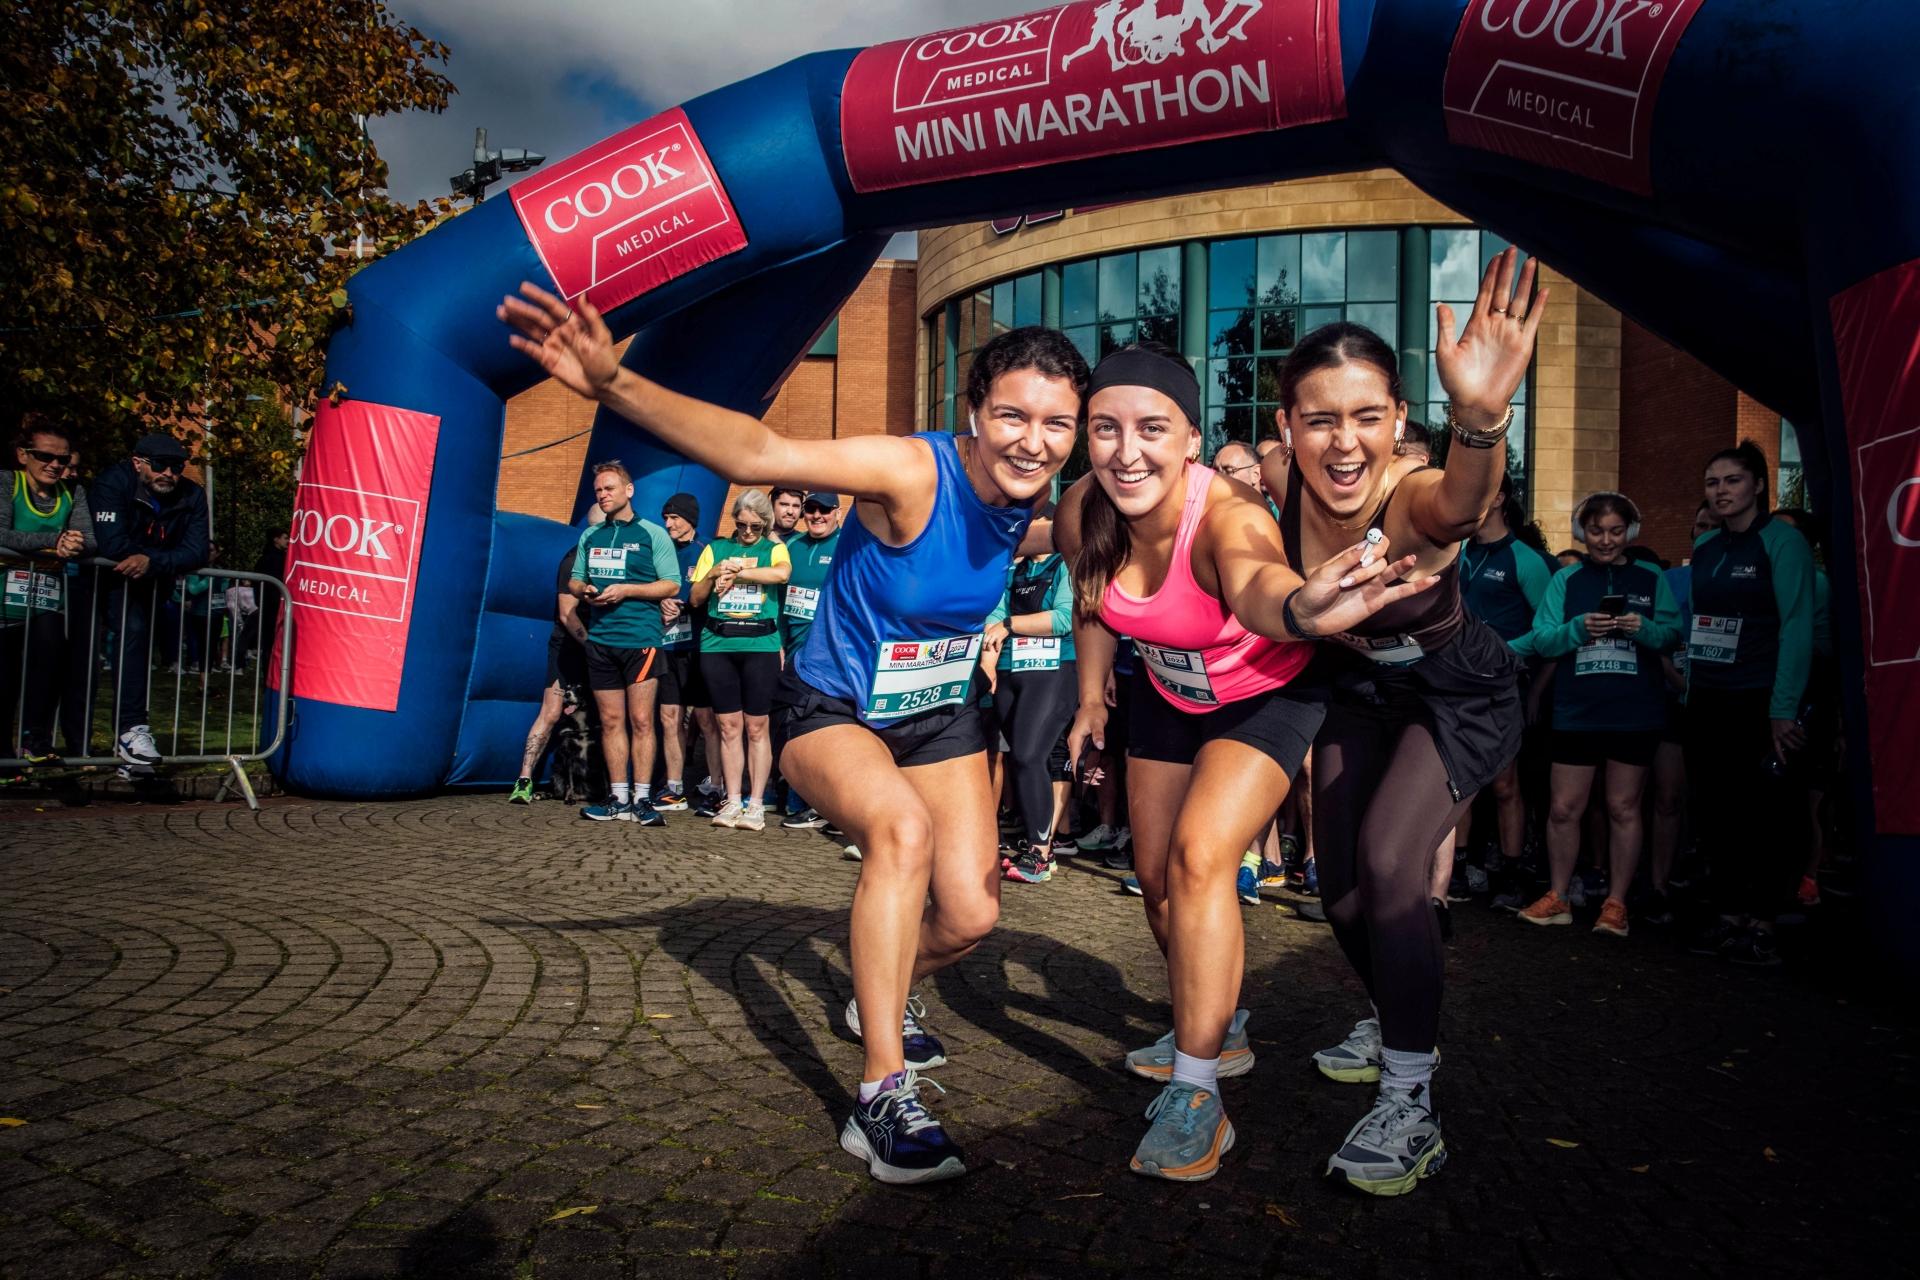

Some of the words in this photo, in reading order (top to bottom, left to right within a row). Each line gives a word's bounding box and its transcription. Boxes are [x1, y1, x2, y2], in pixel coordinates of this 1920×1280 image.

[947, 63, 1032, 90] MEDICAL
[894, 111, 987, 163] MINI
[993, 59, 1271, 146] MARATHON
[1507, 87, 1595, 129] MEDICAL
[616, 211, 695, 257] MEDICAL
[96, 511, 117, 522] HH
[598, 568, 615, 576] 3377
[299, 578, 371, 603] MEDICAL
[22, 595, 48, 606] 156
[1701, 646, 1723, 658] 1607
[889, 661, 906, 669] MINI
[906, 658, 942, 669] MARATHON
[1023, 659, 1047, 667] 2120
[1166, 656, 1185, 664] 2024
[1591, 660, 1621, 670] 2448
[898, 686, 942, 710] 2528
